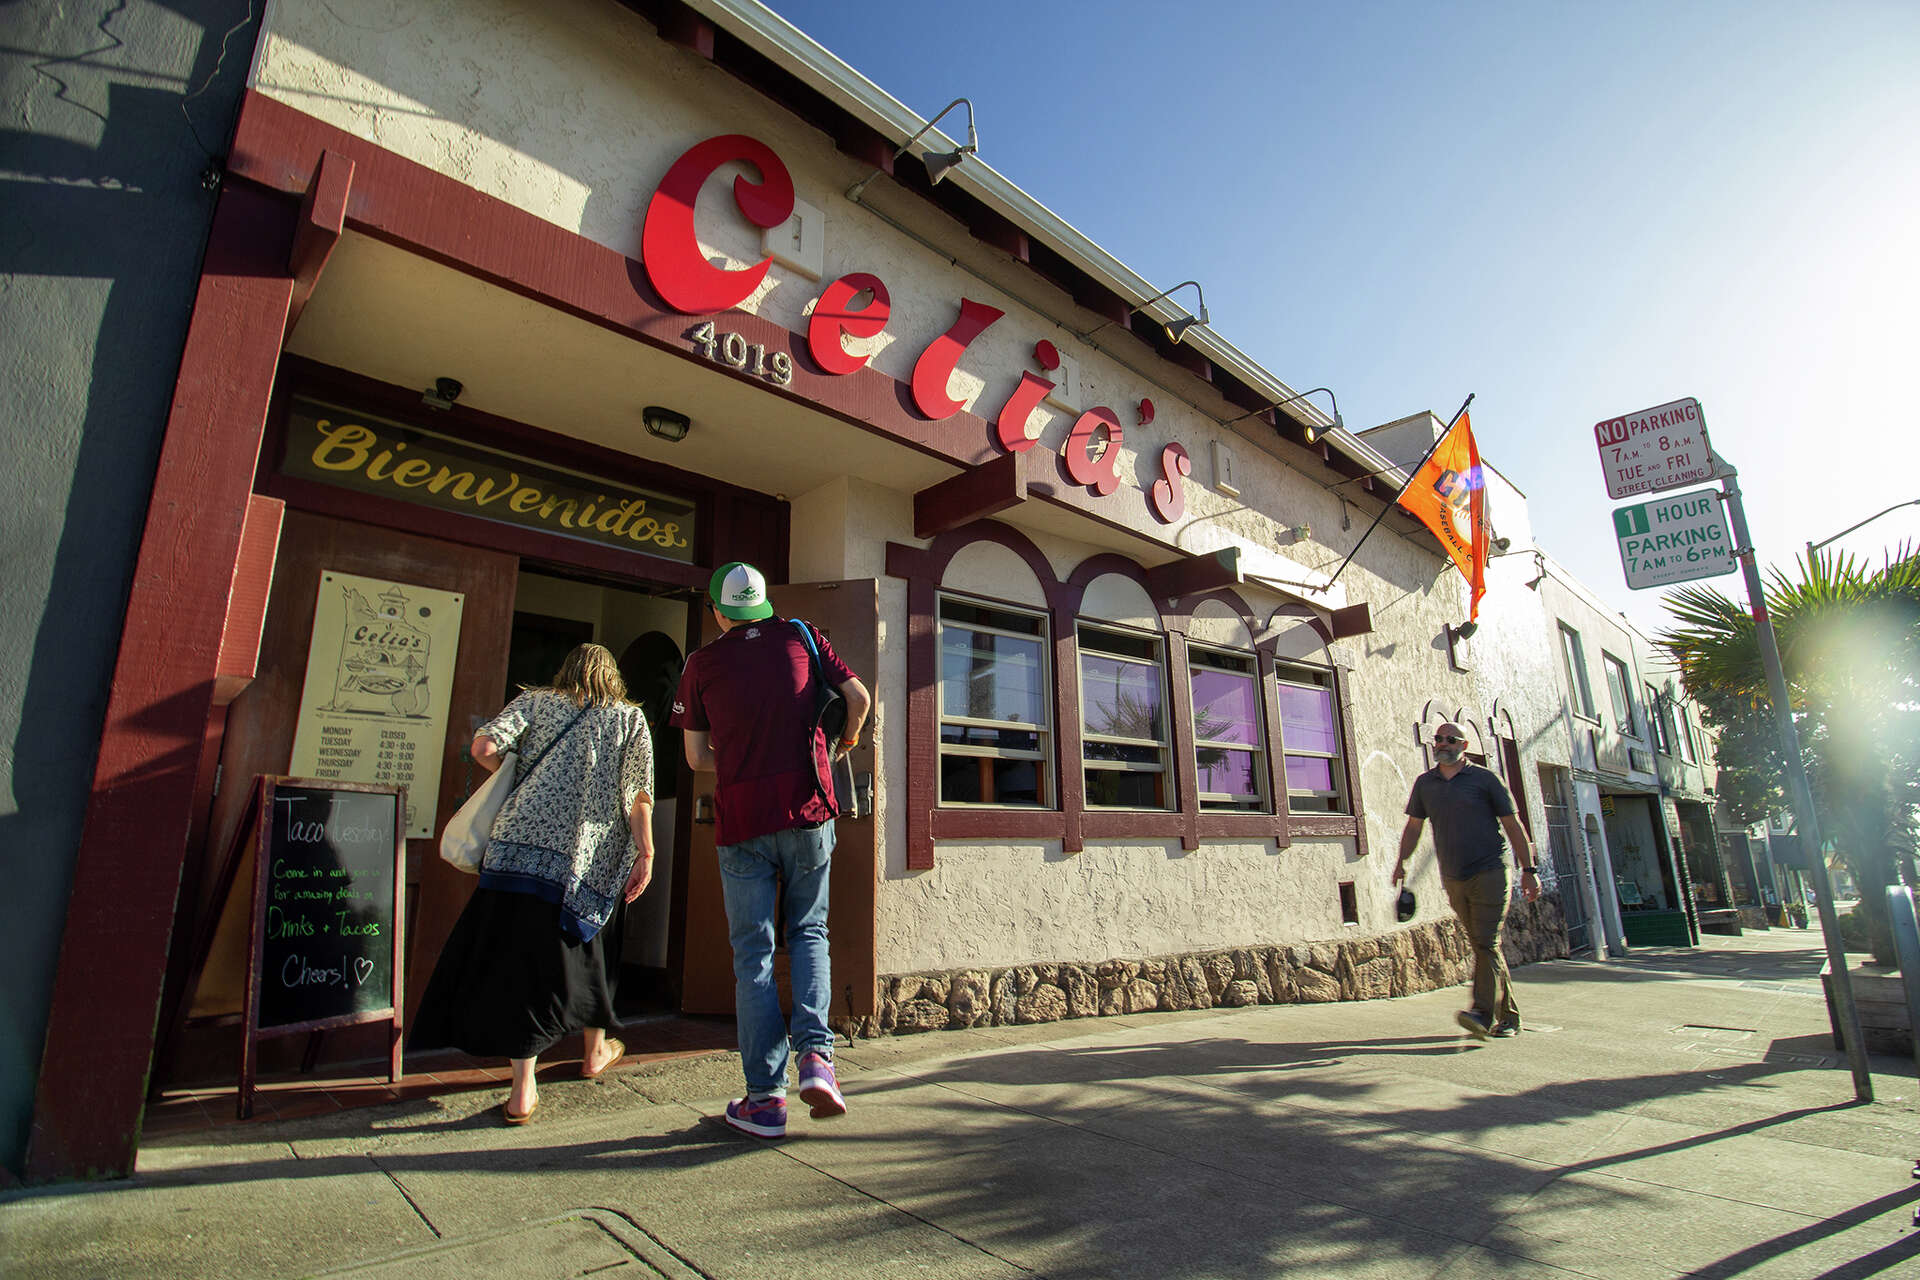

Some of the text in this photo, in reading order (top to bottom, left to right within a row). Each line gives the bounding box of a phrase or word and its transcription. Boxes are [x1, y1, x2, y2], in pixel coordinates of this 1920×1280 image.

[642, 134, 1191, 523] Celia's
[692, 320, 792, 385] 4019
[1598, 404, 1696, 444] NO PARKING
[1643, 441, 1651, 449] TO
[1616, 467, 1704, 496] STREET CLEANING
[1617, 453, 1691, 482] TUE AND FRI
[311, 419, 687, 549] Bienvenidos
[1440, 502, 1462, 554] BASEBALL
[1624, 498, 1713, 534] 1 HOUR
[1626, 524, 1722, 556] PARKING
[1670, 554, 1682, 563] TO
[354, 625, 421, 648] Celia's
[320, 736, 352, 747] TUESDAY
[321, 726, 406, 740] MONDAY CLOSED
[317, 757, 354, 768] THURSDAY
[319, 747, 361, 758] WEDNESDAY
[315, 768, 341, 778] FRIDAY
[275, 796, 325, 843] Taco
[274, 858, 309, 879] Come
[313, 866, 323, 877] in
[329, 866, 347, 878] and
[294, 889, 333, 905] amazing
[336, 886, 360, 900] deals
[268, 905, 315, 940] Drinks
[336, 909, 381, 937] Tacos
[281, 954, 349, 989] Cheers!
